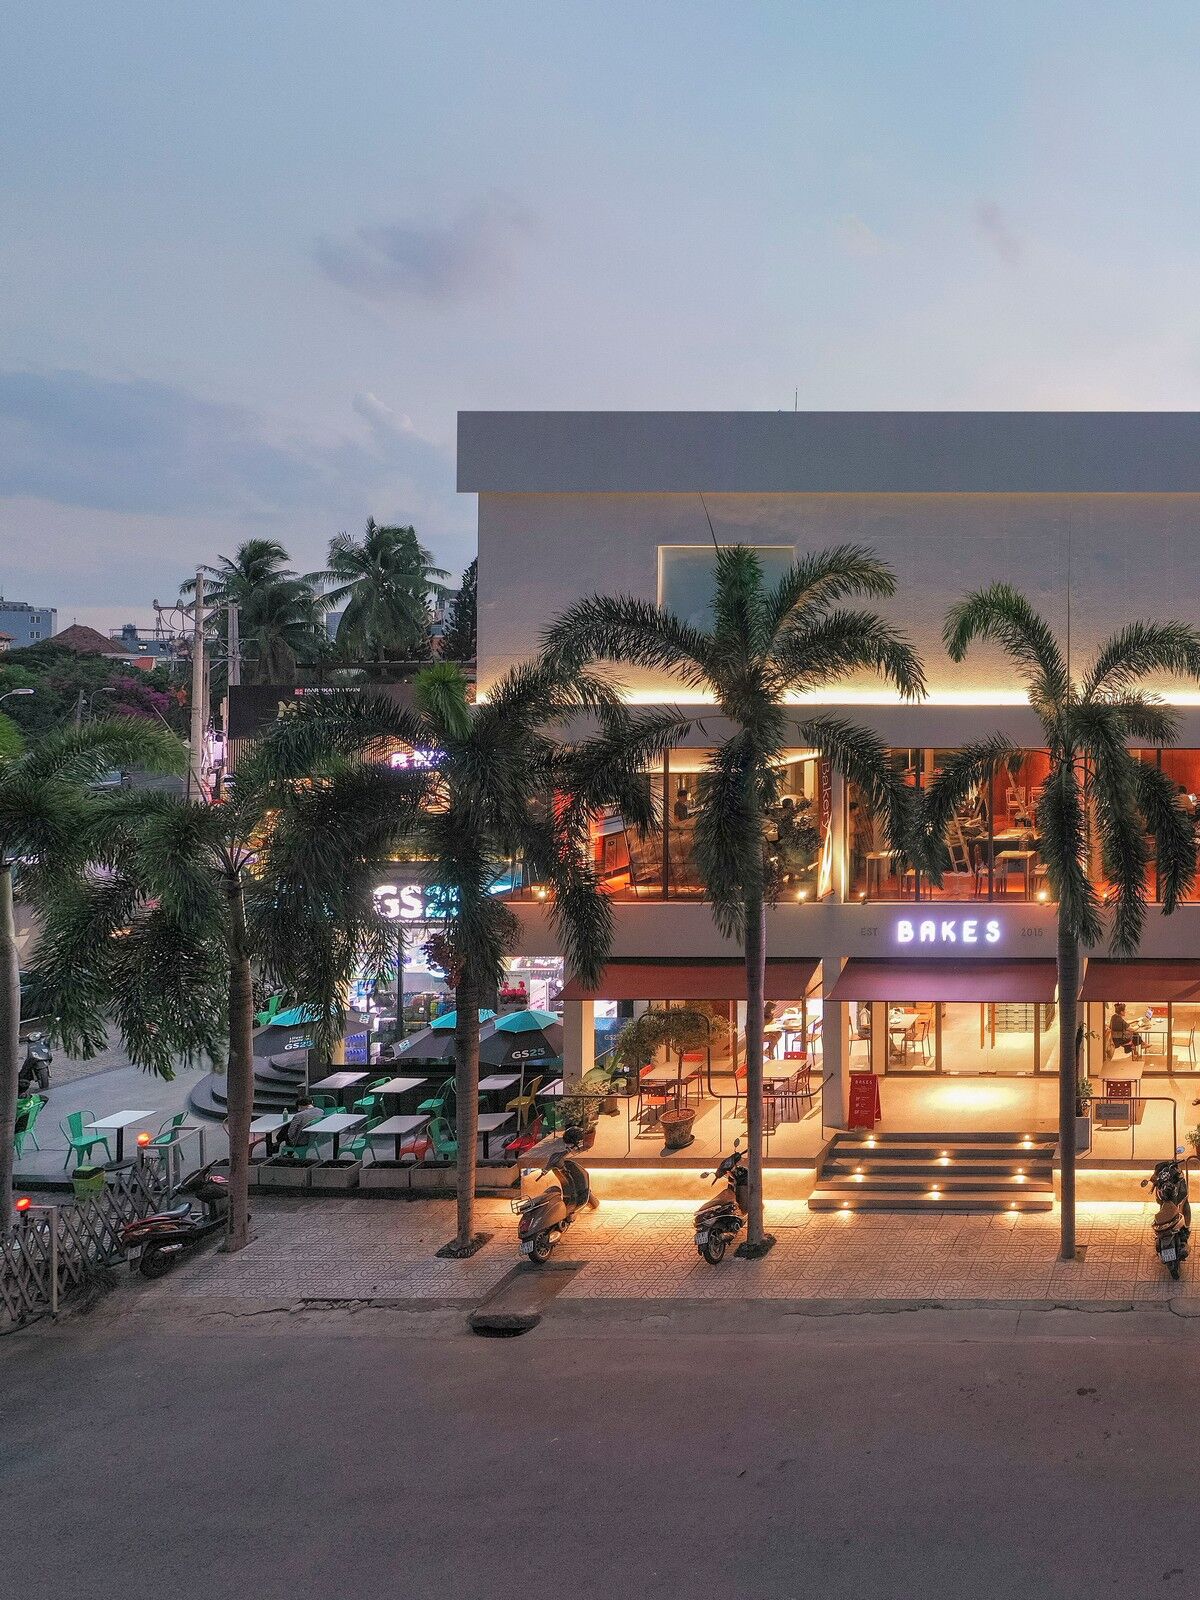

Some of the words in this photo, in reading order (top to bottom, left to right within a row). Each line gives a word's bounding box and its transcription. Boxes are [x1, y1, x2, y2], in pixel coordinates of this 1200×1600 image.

[821, 761, 831, 829] Bakery
[861, 928, 877, 936] EST
[897, 921, 1001, 943] BAKES
[511, 1048, 546, 1059] GS25
